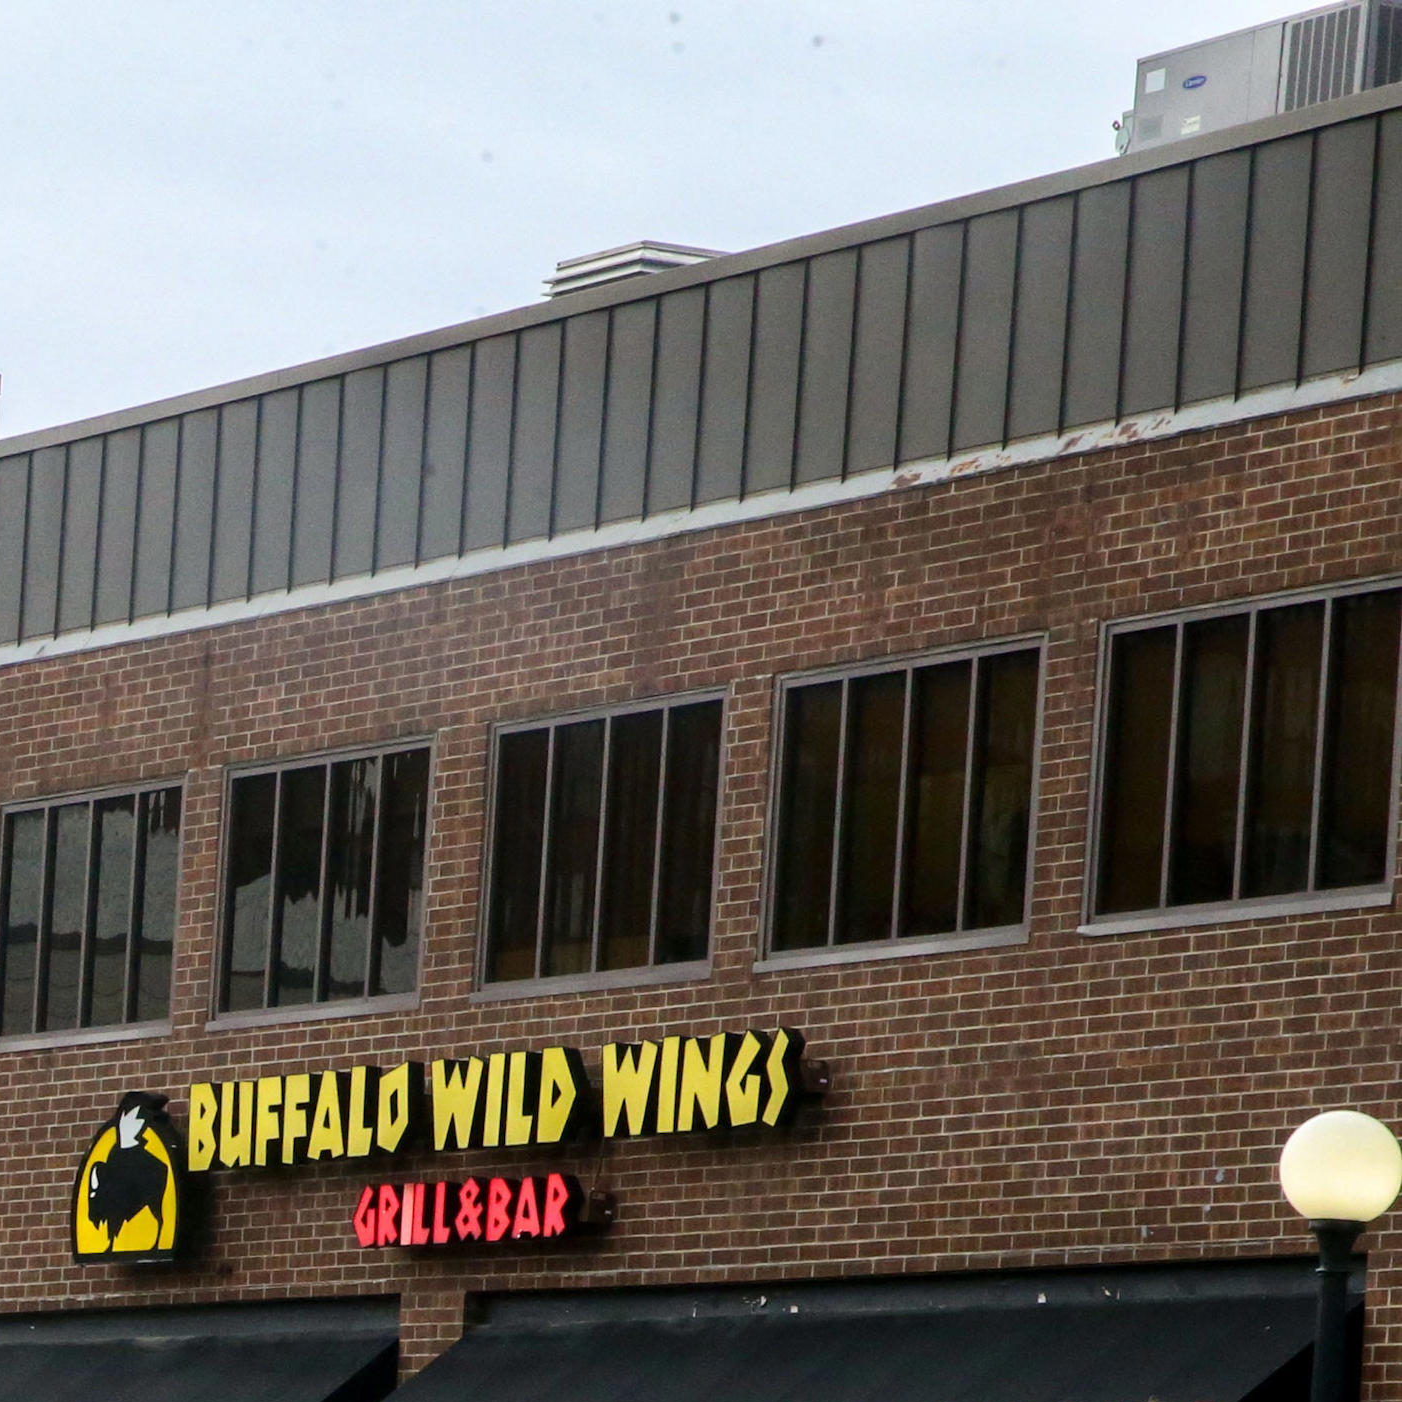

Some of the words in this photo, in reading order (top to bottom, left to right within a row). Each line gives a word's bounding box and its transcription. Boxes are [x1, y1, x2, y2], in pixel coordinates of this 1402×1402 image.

[188, 1061, 412, 1171] BUFFALO
[431, 1047, 578, 1151] WILD
[602, 1028, 794, 1137] WINGS
